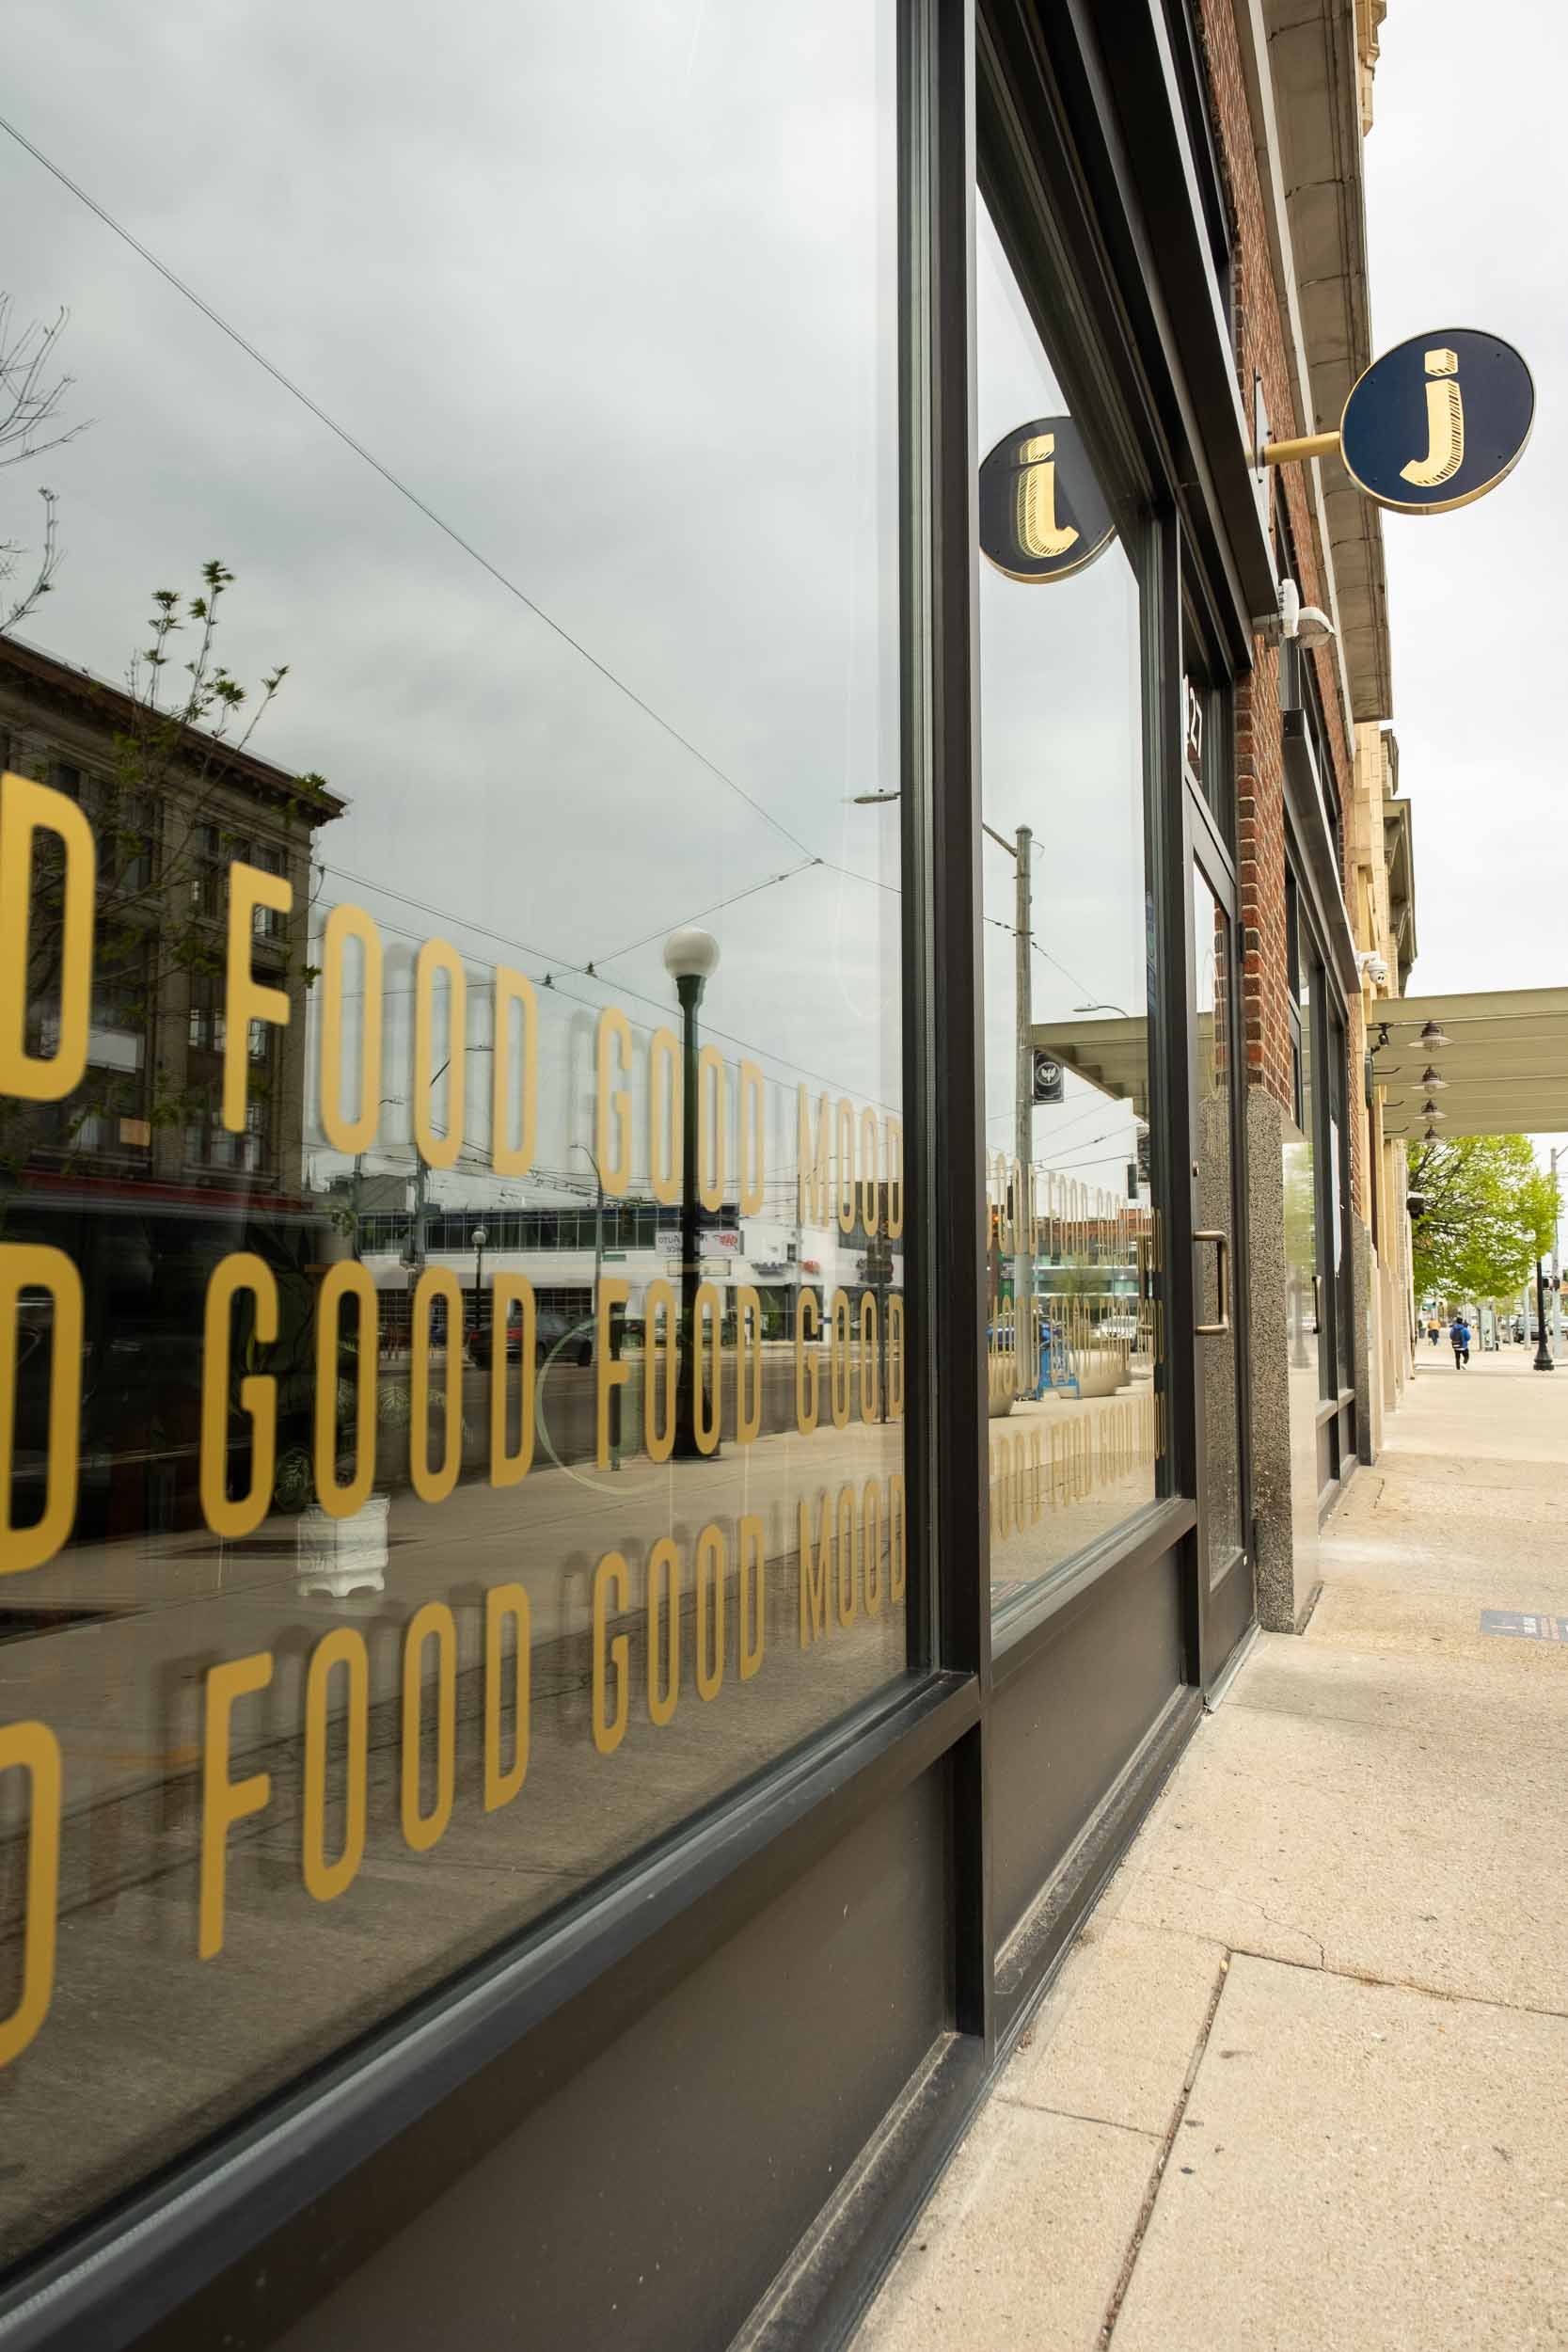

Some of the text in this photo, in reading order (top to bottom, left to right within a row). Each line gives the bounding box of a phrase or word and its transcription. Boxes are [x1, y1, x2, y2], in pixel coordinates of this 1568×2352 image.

[1400, 347, 1465, 487] j
[222, 860, 538, 1176] FOOD
[597, 1007, 765, 1216] GOOD
[798, 1083, 903, 1239] MOOD
[199, 1252, 535, 1539] GOOD
[596, 1278, 762, 1470] FOOD
[797, 1286, 904, 1437] GOOD
[198, 1582, 531, 1961] FOOD
[593, 1515, 765, 1755] GOOD
[799, 1474, 906, 1649] MOOD
